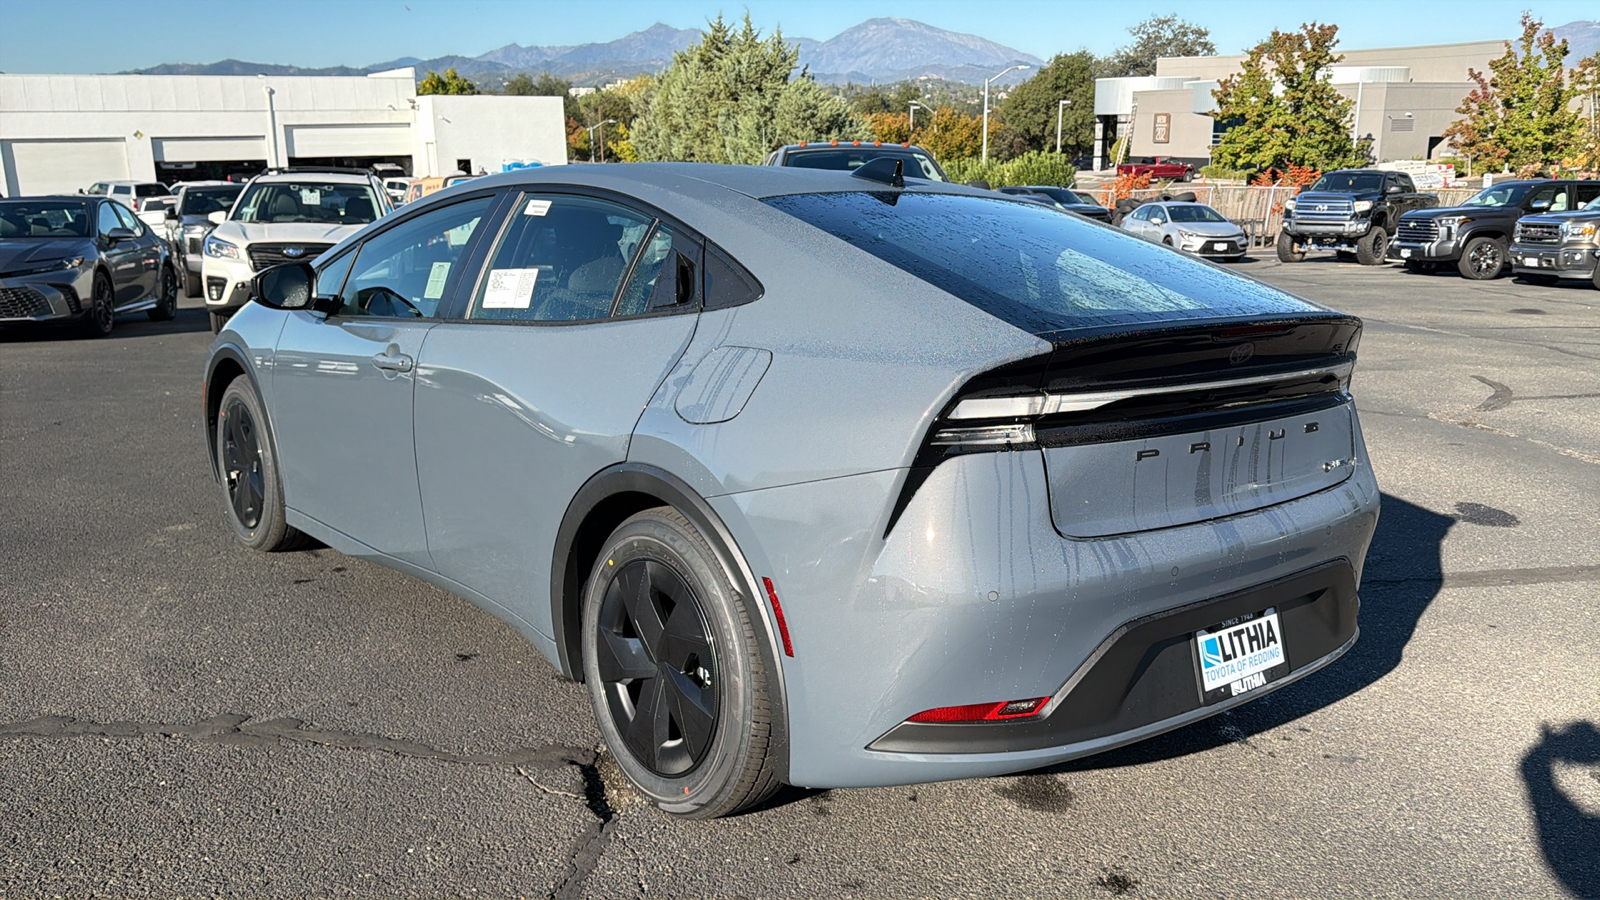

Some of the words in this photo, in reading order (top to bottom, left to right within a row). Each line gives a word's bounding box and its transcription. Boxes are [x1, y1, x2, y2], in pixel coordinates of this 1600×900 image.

[1137, 422, 1319, 461] PRIUS
[1221, 617, 1239, 628] SINCE
[1218, 619, 1278, 663] LITHIA
[1205, 662, 1236, 683] TOYOTA
[1236, 658, 1247, 672] OF
[1248, 647, 1280, 668] REDDING
[1239, 671, 1267, 694] LITHIA
